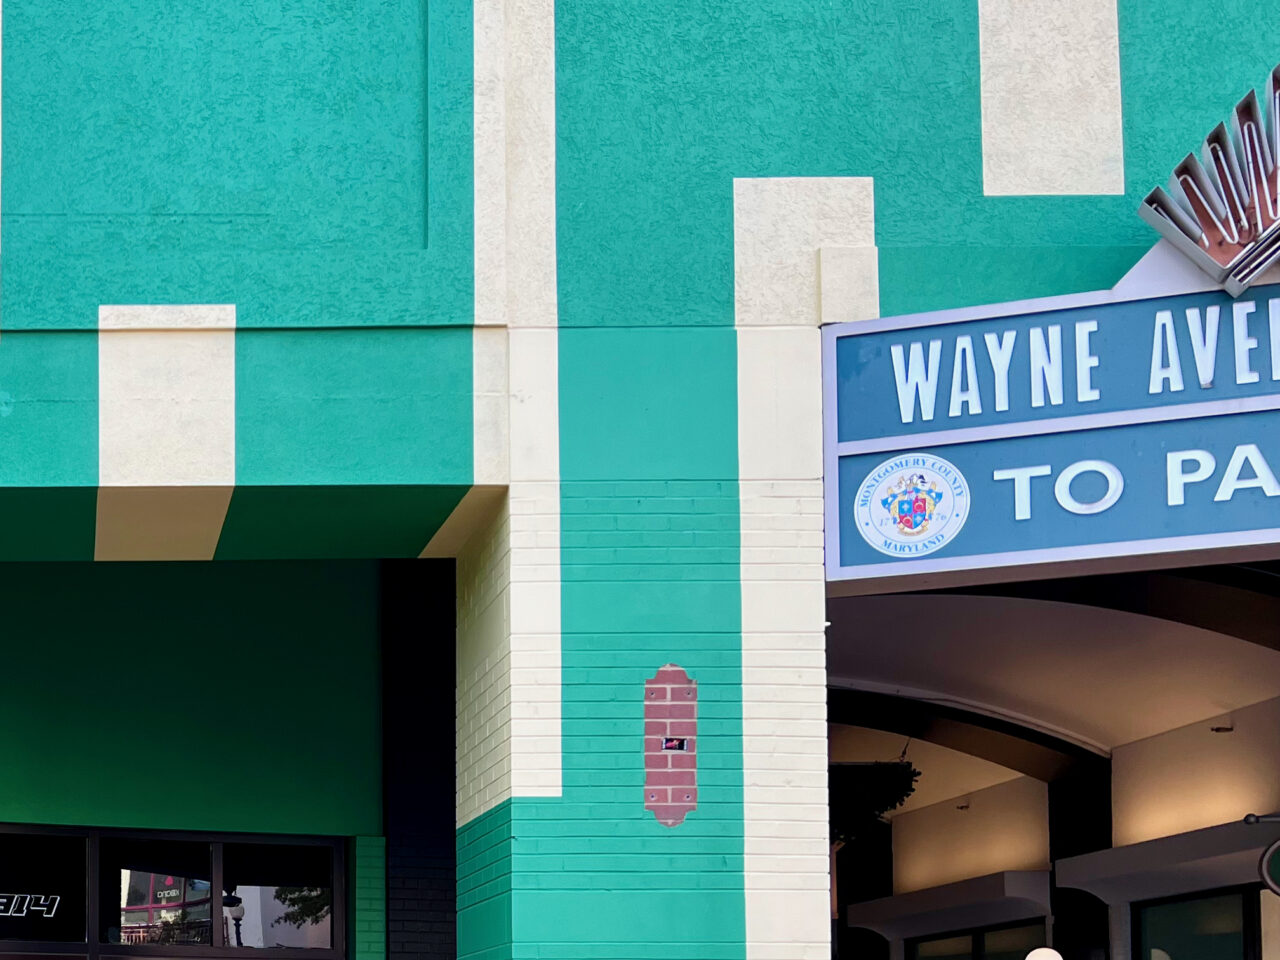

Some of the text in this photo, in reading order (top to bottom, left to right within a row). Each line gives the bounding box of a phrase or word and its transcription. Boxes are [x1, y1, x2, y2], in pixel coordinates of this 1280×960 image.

[890, 320, 1101, 424] WAYNE
[860, 458, 964, 507] MONTGOMERY COUNTY
[993, 444, 1280, 520] TO PA
[883, 534, 944, 553] MARYLAND
